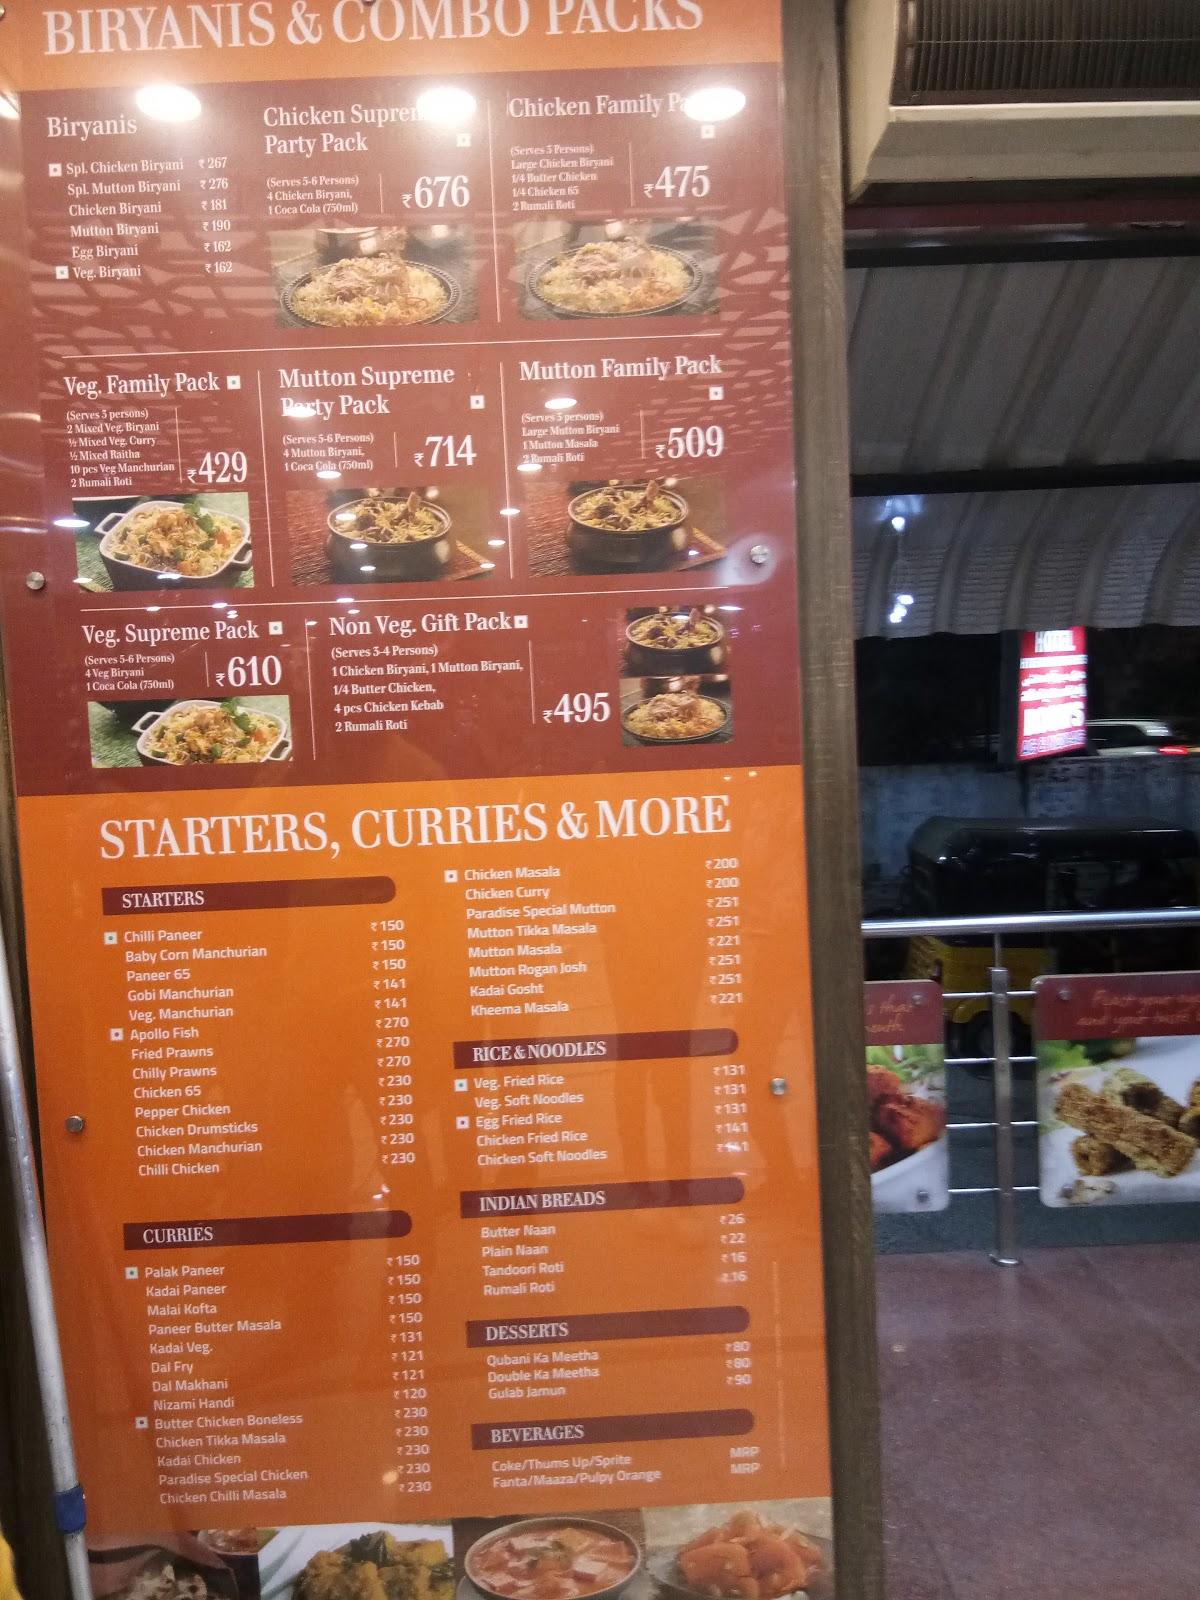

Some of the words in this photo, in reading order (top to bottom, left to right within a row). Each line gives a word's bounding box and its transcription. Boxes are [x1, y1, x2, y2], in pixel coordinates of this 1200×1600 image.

[43, 2, 275, 55] BIRYANIS
[286, 0, 322, 46] &
[333, 0, 529, 44] COMBO
[545, 0, 703, 35] PACKS
[509, 96, 591, 118] Chicken
[596, 93, 662, 118] Family
[263, 106, 348, 127] Chicken
[47, 114, 137, 141] Biryanis
[264, 135, 318, 158] Party
[322, 132, 368, 152] Pack
[67, 161, 87, 176] Spl.
[90, 160, 137, 174] Chicken
[140, 158, 183, 175] Biryani
[68, 182, 89, 197] Spl.
[92, 181, 135, 195] Mutton
[138, 179, 181, 196] Biryani
[266, 176, 300, 189] (Serves
[320, 175, 359, 187] Persons)
[267, 191, 273, 200] 4
[275, 189, 312, 201] Chicken
[314, 188, 354, 201] Biryani,
[69, 202, 115, 217] Chicken
[117, 201, 162, 218] Biryani
[71, 223, 113, 238] Mutton
[117, 222, 159, 239] Biryani
[72, 245, 93, 261] Egg
[96, 243, 138, 260] Biryani
[99, 264, 141, 280] Biryani
[279, 366, 357, 389] Mutton
[361, 365, 456, 391] Supreme
[520, 360, 596, 382] Mutton
[601, 357, 671, 385] Family
[674, 355, 722, 374] Pack
[106, 373, 171, 399] Family
[175, 371, 220, 391] Pack
[339, 395, 391, 415] Pack
[67, 424, 73, 433] 2
[75, 423, 103, 434] Mixed
[126, 421, 160, 433] Biryani
[70, 465, 79, 474] 10
[81, 466, 98, 476] pcs
[99, 464, 117, 476] Veg
[118, 462, 175, 473] Manchurian
[71, 479, 77, 487] 2
[79, 477, 111, 487] Rumali
[113, 476, 133, 486] Roti
[329, 616, 371, 636] Non
[421, 612, 460, 632] Gift
[464, 612, 512, 630] Pack
[125, 622, 210, 647] Supreme
[214, 620, 259, 641] Pack
[84, 654, 118, 666] (Serves
[135, 653, 175, 665] Persons)
[332, 667, 337, 676] 1
[339, 665, 384, 676] Chicken
[386, 664, 429, 678] Biryani,
[431, 663, 436, 673] 1
[439, 661, 478, 673] Mutton
[480, 660, 523, 673] Biryani,
[333, 684, 349, 696] 1/4
[351, 683, 386, 695] Butter
[388, 682, 436, 696] Chicken,
[334, 704, 341, 713] 4
[343, 705, 361, 715] pcs
[364, 701, 408, 713] Chicken
[411, 700, 444, 711] Kebab
[336, 722, 342, 732] 2
[345, 720, 383, 732] Rumali
[385, 719, 407, 731] Roti
[100, 812, 340, 861] STARTERS,
[352, 802, 548, 849] CURRIES
[556, 801, 590, 840] &
[594, 794, 731, 838] MORE
[464, 868, 512, 881] Chicken
[515, 866, 561, 880] Masala
[122, 890, 205, 909] STARTERS
[466, 907, 520, 920] Paradise
[523, 904, 567, 919] Special
[570, 902, 616, 915] Mutton
[124, 930, 154, 943] Chilli
[158, 929, 202, 942] Paneer
[130, 1028, 169, 1042] Apollo
[173, 1027, 199, 1039] Fish
[473, 1046, 511, 1063] RICE
[514, 1045, 525, 1061] &
[528, 1041, 606, 1060] NOODLES
[504, 1075, 535, 1087] Fried
[538, 1073, 564, 1086] Rice
[135, 1106, 179, 1121] Pepper
[182, 1103, 231, 1117] Chicken
[136, 1125, 184, 1138] Chicken
[187, 1121, 258, 1136] Drumsticks
[479, 1194, 538, 1212] INDIAN
[541, 1191, 606, 1209] BREADS
[143, 1227, 213, 1244] CURRIES
[481, 1226, 519, 1239] Butter
[523, 1224, 556, 1236] Naan
[144, 1266, 179, 1278] Palak
[182, 1265, 225, 1277] Paneer
[482, 1264, 537, 1277] Tandoori
[539, 1262, 564, 1274] Roti
[486, 1323, 568, 1341] DESSERTS
[150, 1343, 183, 1355] Kadai
[151, 1362, 171, 1374] Dal
[174, 1361, 194, 1376] Fry
[489, 1387, 524, 1399] Gulab
[527, 1386, 566, 1398] Jamun
[155, 1417, 193, 1430] Butter
[197, 1415, 244, 1428] Chicken
[247, 1413, 303, 1426] Boneless
[491, 1425, 584, 1443] BEVERAGES
[617, 1469, 662, 1483] Orange
[730, 1463, 760, 1474] MRP
